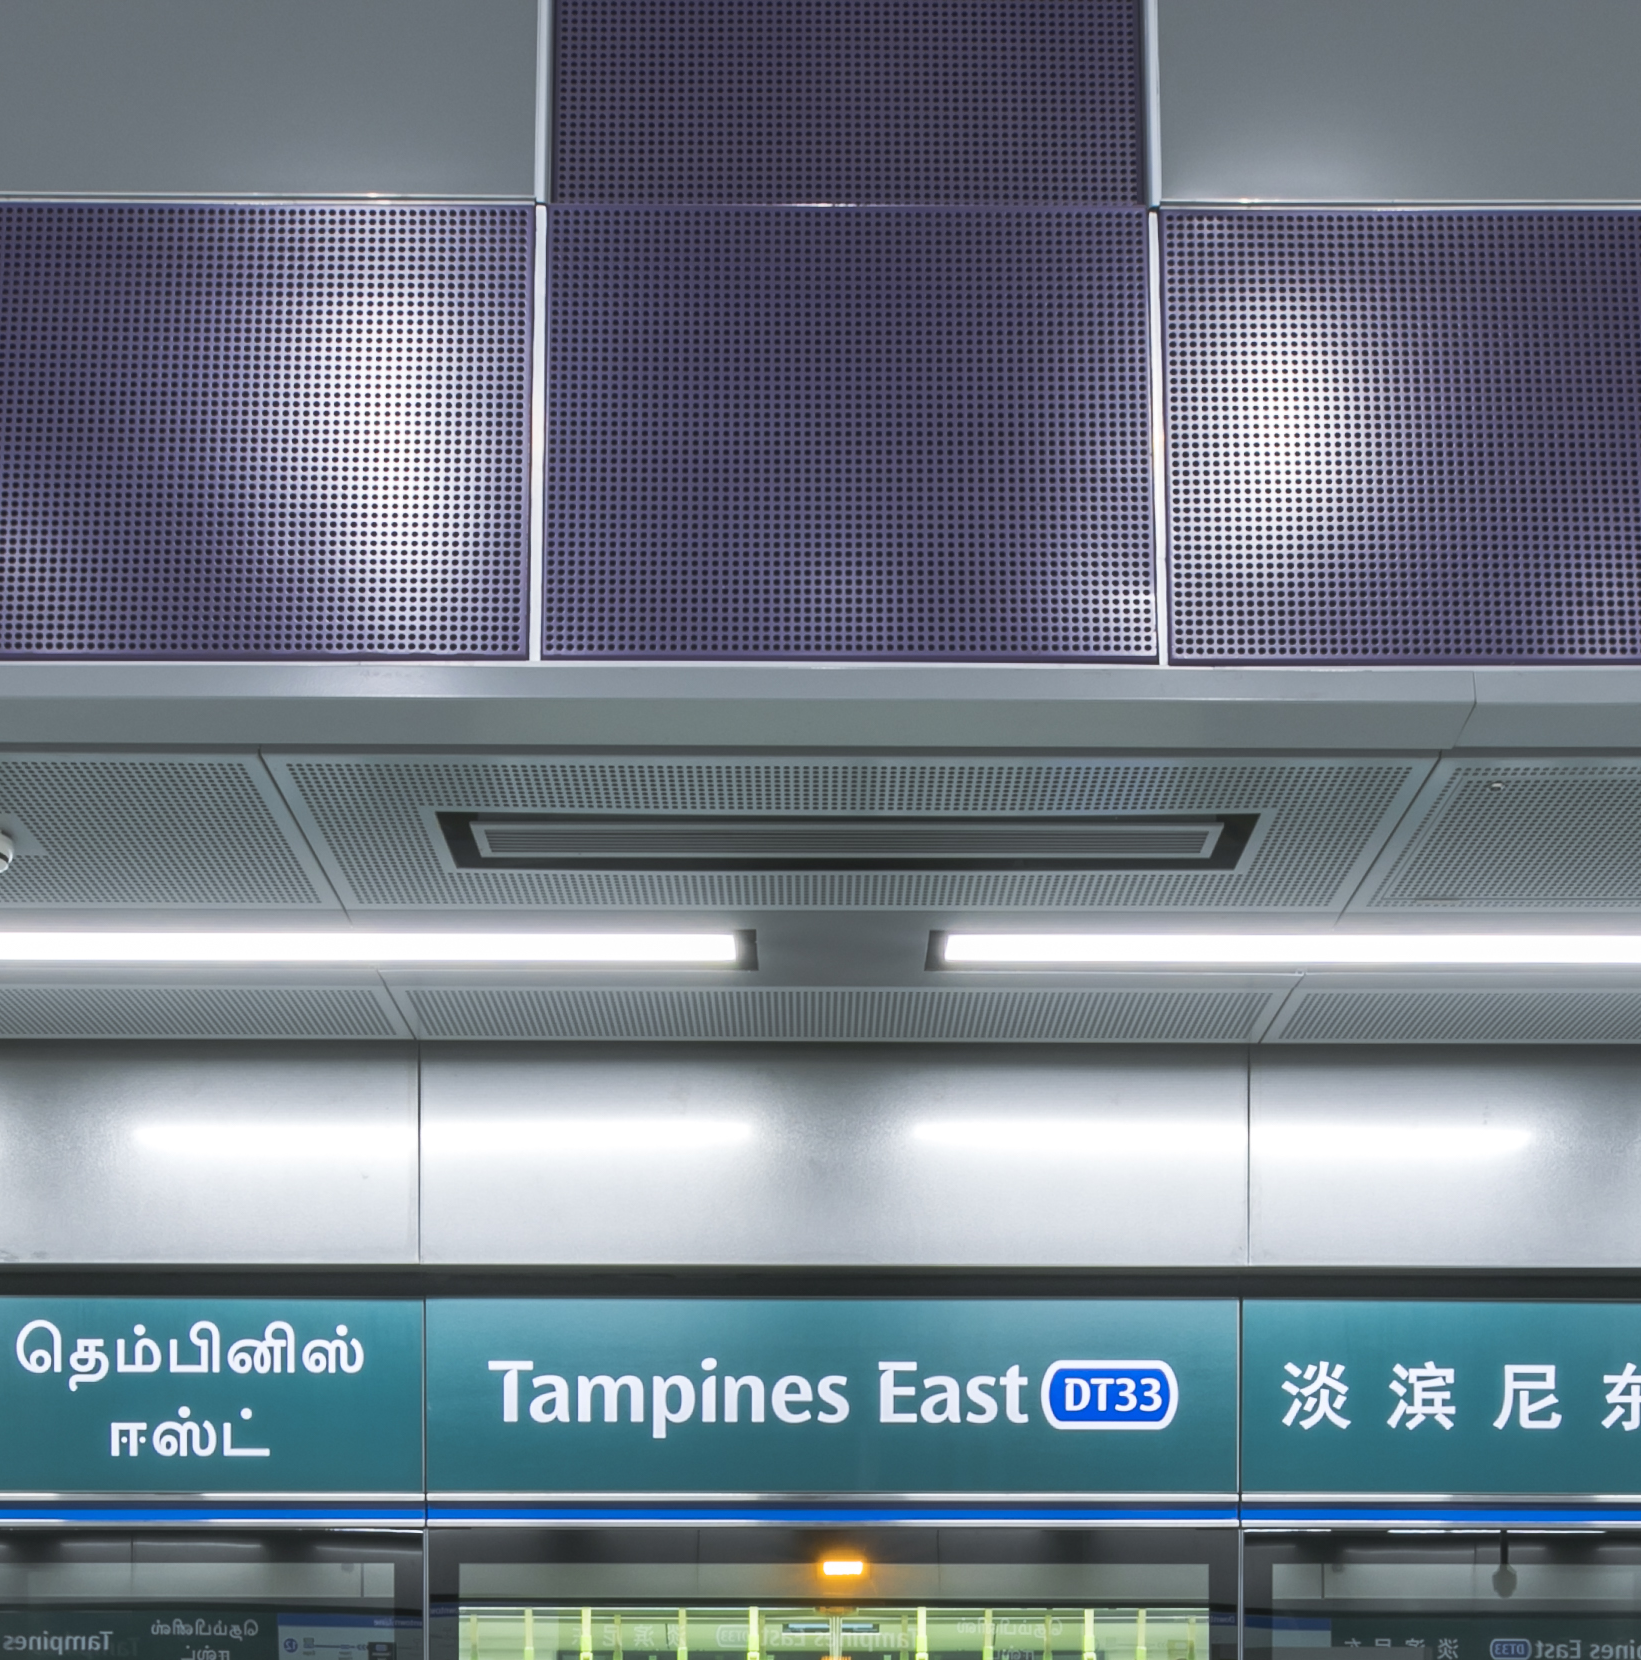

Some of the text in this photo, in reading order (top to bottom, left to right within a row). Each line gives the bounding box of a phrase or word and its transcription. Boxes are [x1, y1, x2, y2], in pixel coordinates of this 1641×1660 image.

[16, 1319, 365, 1392] தெம்பினிஸ்
[110, 1405, 271, 1457] ஈஸ்ட்
[487, 1357, 1165, 1439] Tampines East DT33
